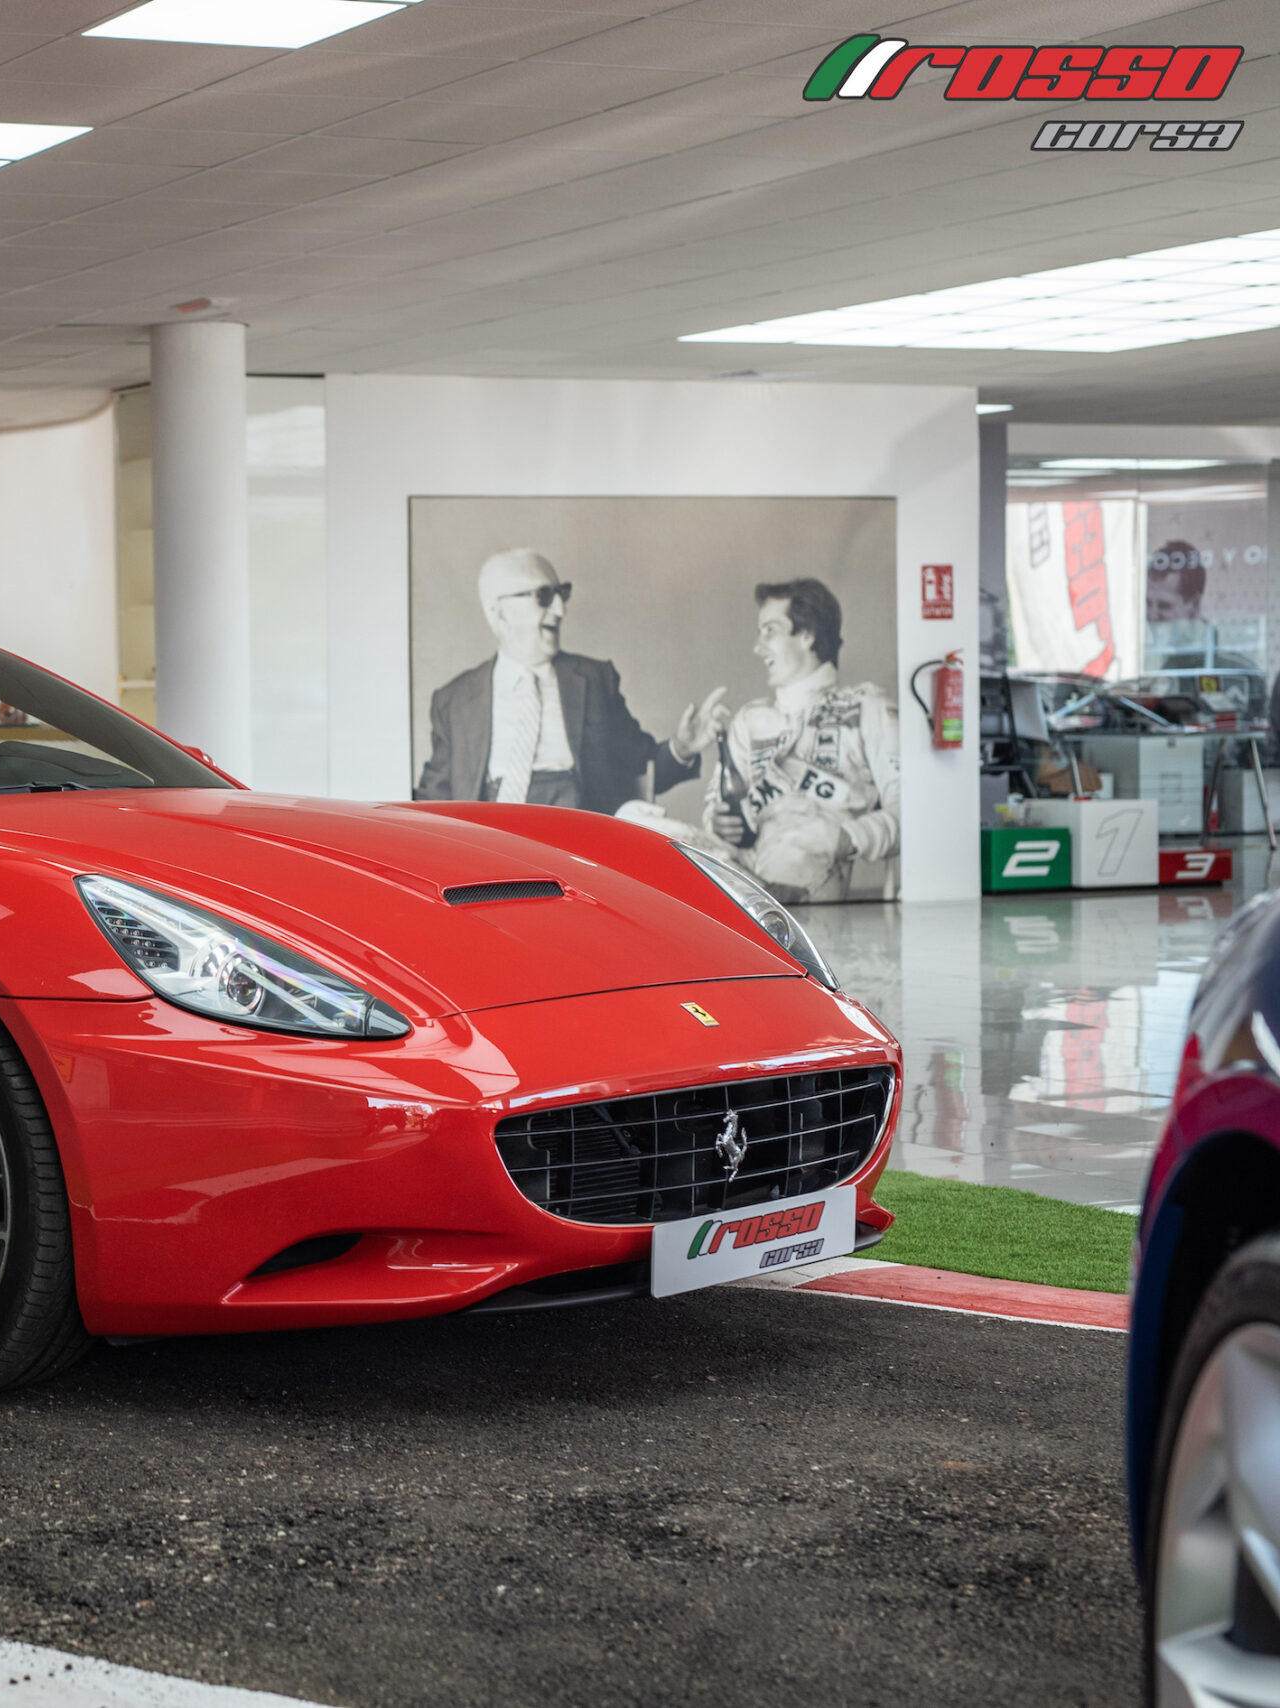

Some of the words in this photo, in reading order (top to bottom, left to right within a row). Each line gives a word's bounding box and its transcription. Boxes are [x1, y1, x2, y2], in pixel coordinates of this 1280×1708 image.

[1002, 840, 1061, 878] 2
[1096, 808, 1144, 877] 1
[1175, 852, 1216, 879] 3
[708, 1200, 826, 1255] rosso
[759, 1237, 825, 1269] corsa
